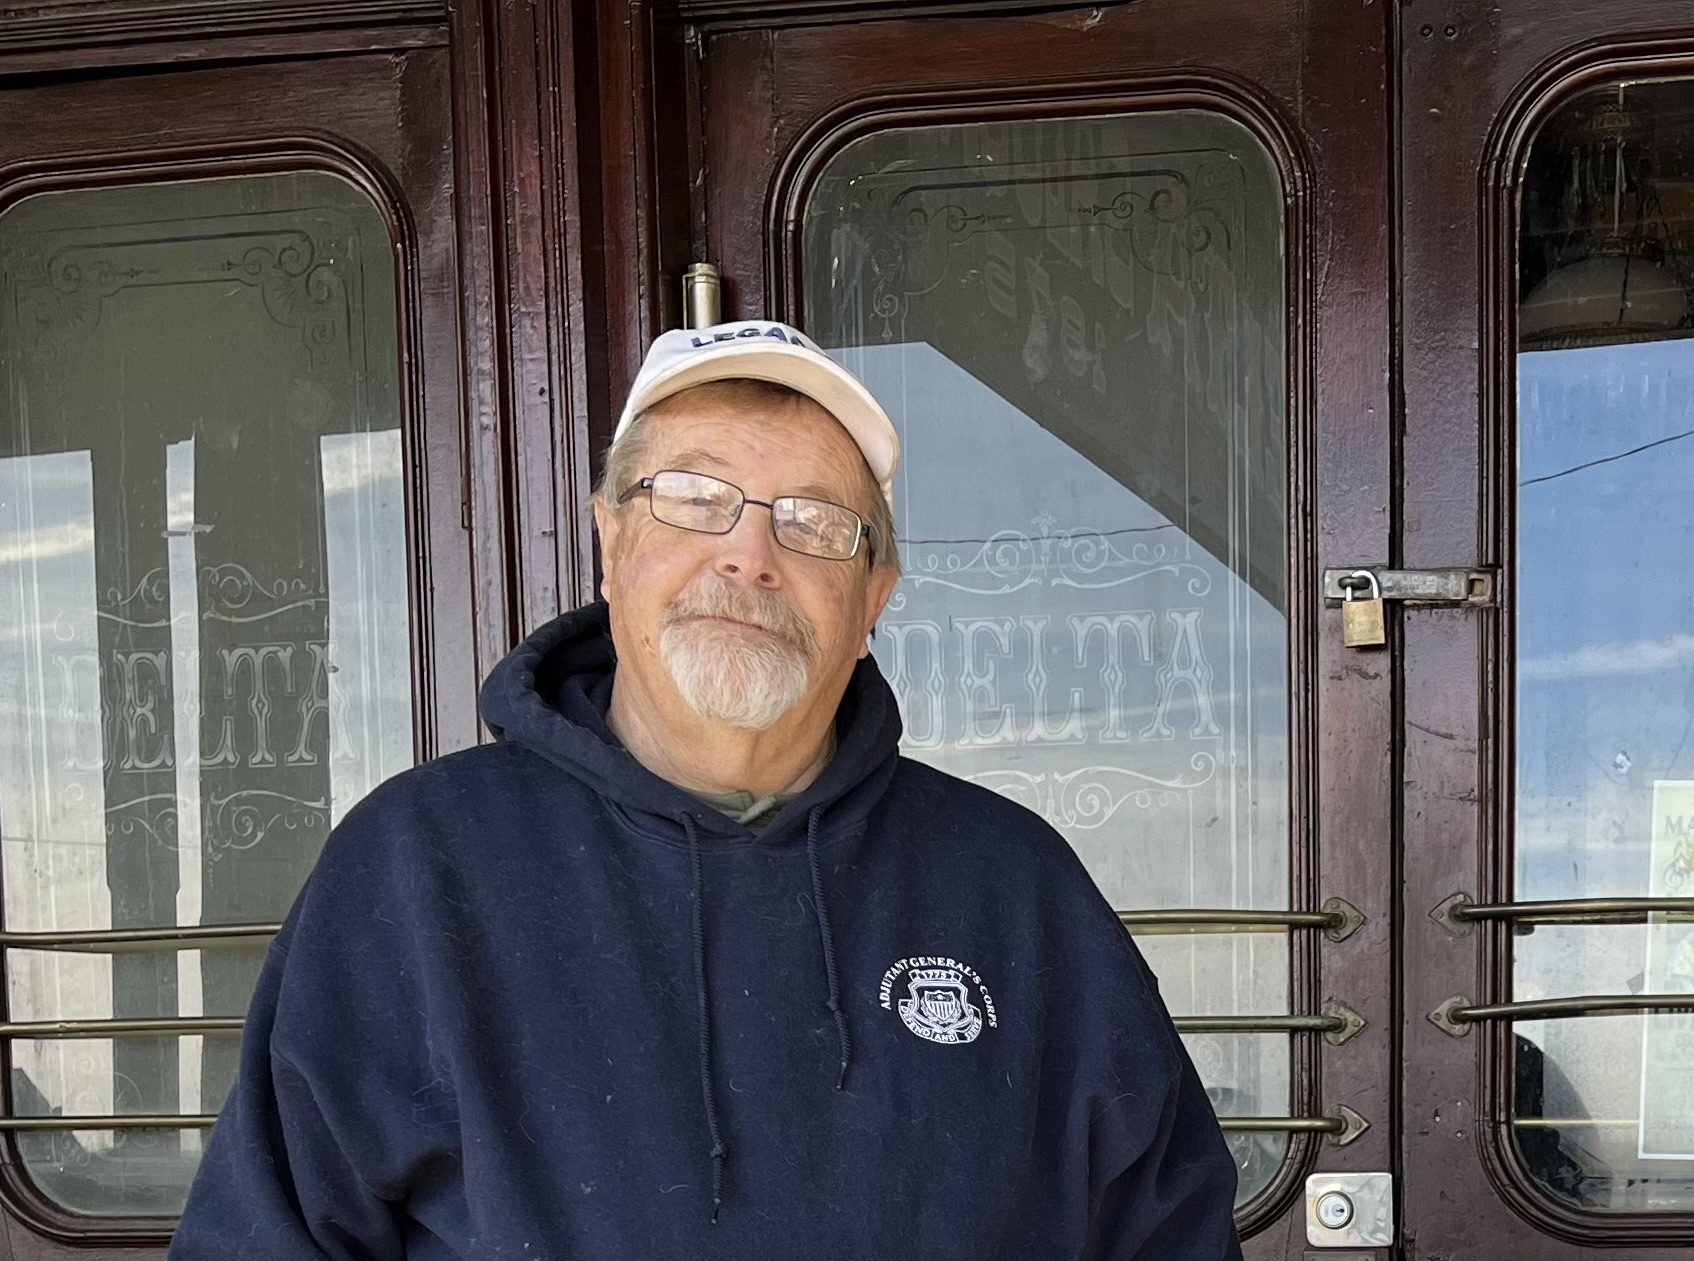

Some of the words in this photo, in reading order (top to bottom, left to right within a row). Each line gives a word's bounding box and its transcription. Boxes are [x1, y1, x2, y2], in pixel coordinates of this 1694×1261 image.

[53, 641, 359, 773] DELTA
[882, 608, 1223, 751] DELTA
[879, 959, 909, 1010] ADJUTANT
[909, 957, 982, 984] GENERAL'S
[980, 985, 998, 1028] CORPS
[935, 1032, 956, 1041] AND
